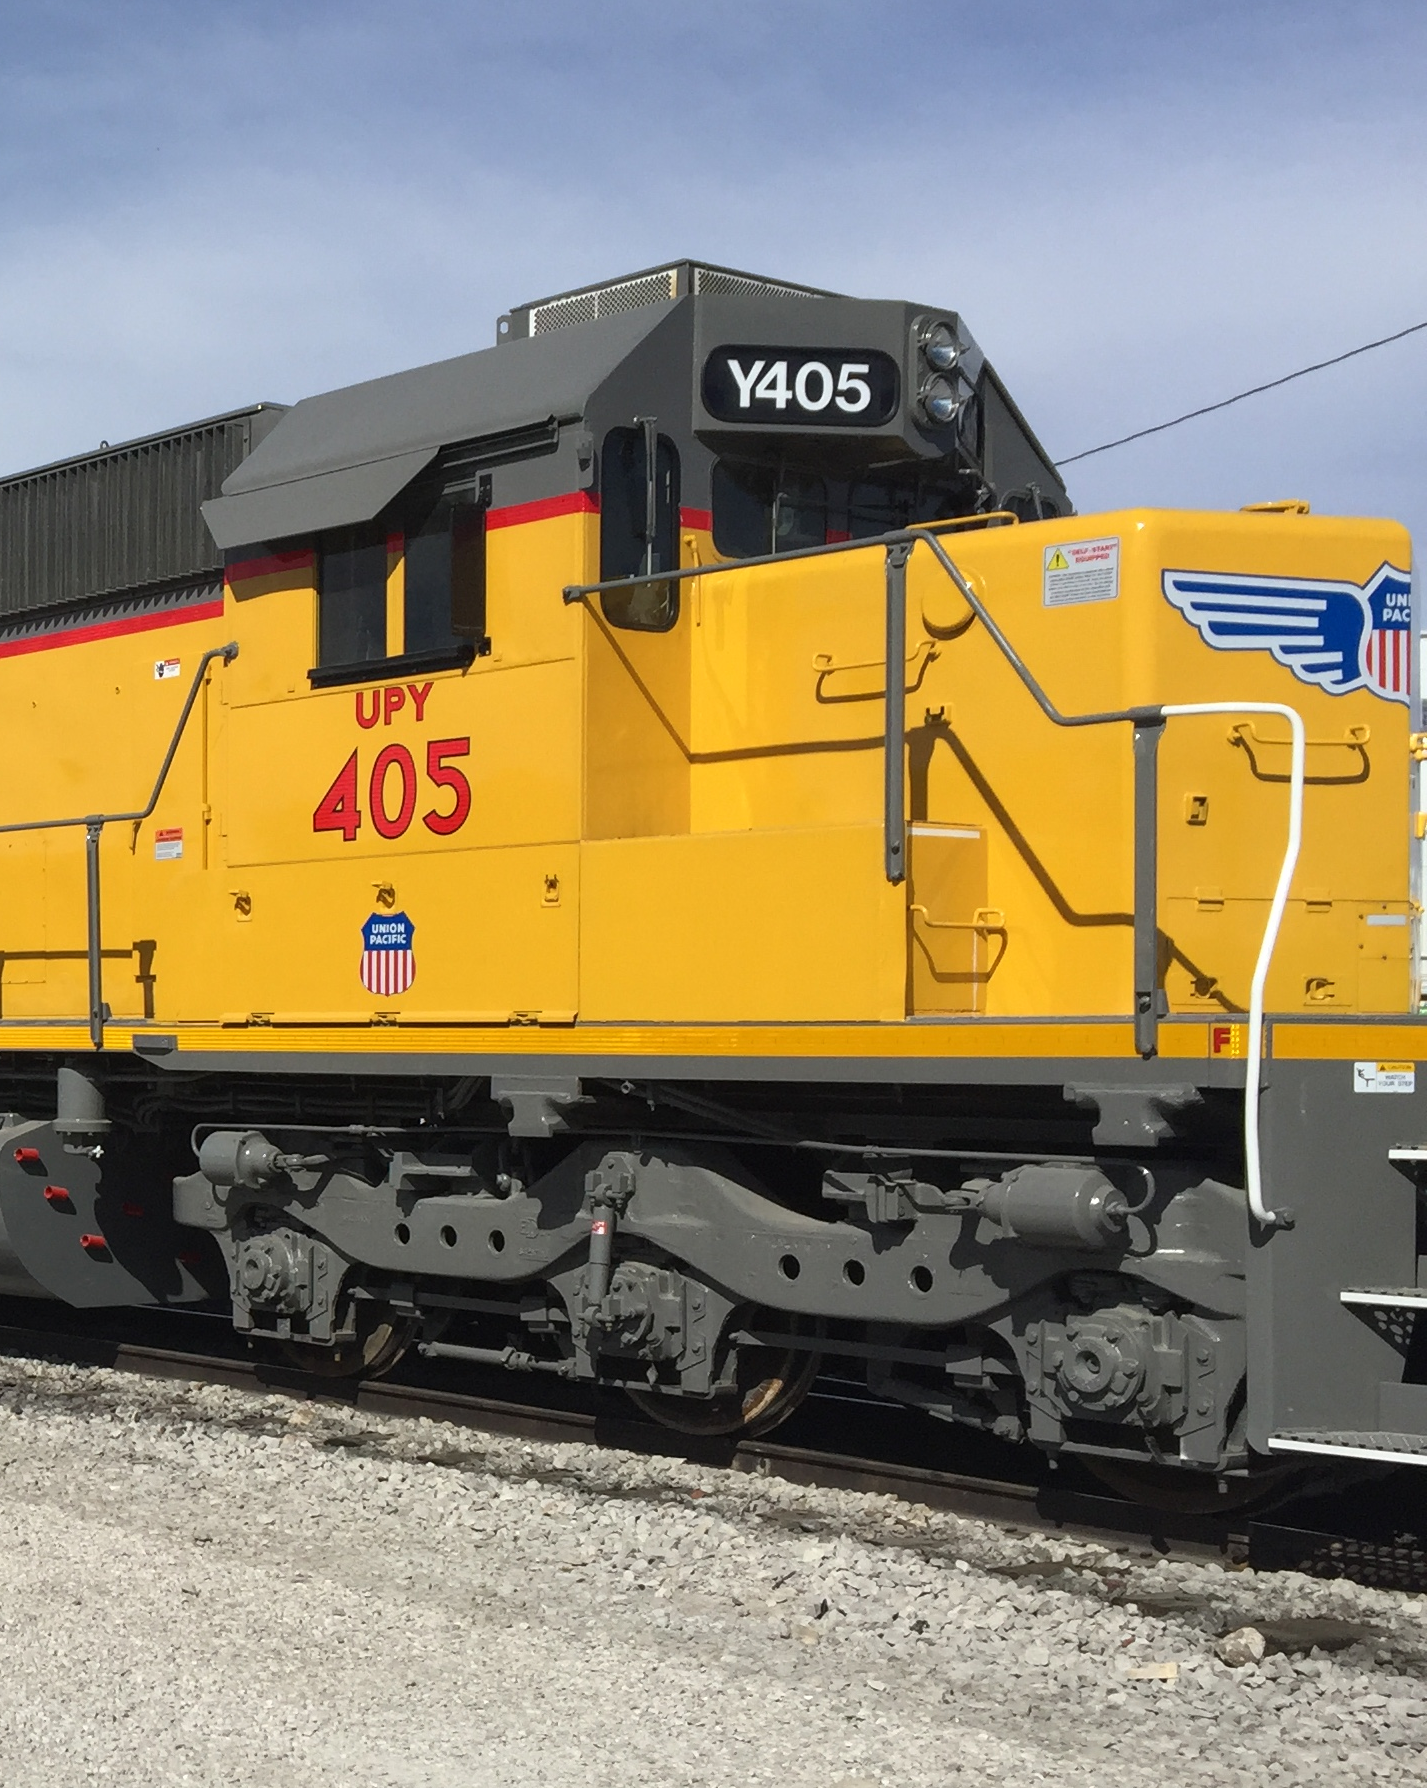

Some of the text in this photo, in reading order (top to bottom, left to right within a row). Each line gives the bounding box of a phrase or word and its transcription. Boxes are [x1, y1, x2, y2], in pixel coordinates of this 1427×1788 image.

[726, 358, 872, 413] Y405
[355, 681, 435, 730] UPY
[312, 736, 472, 843] 405
[369, 934, 407, 945] PACIFIC
[371, 922, 406, 934] UNION
